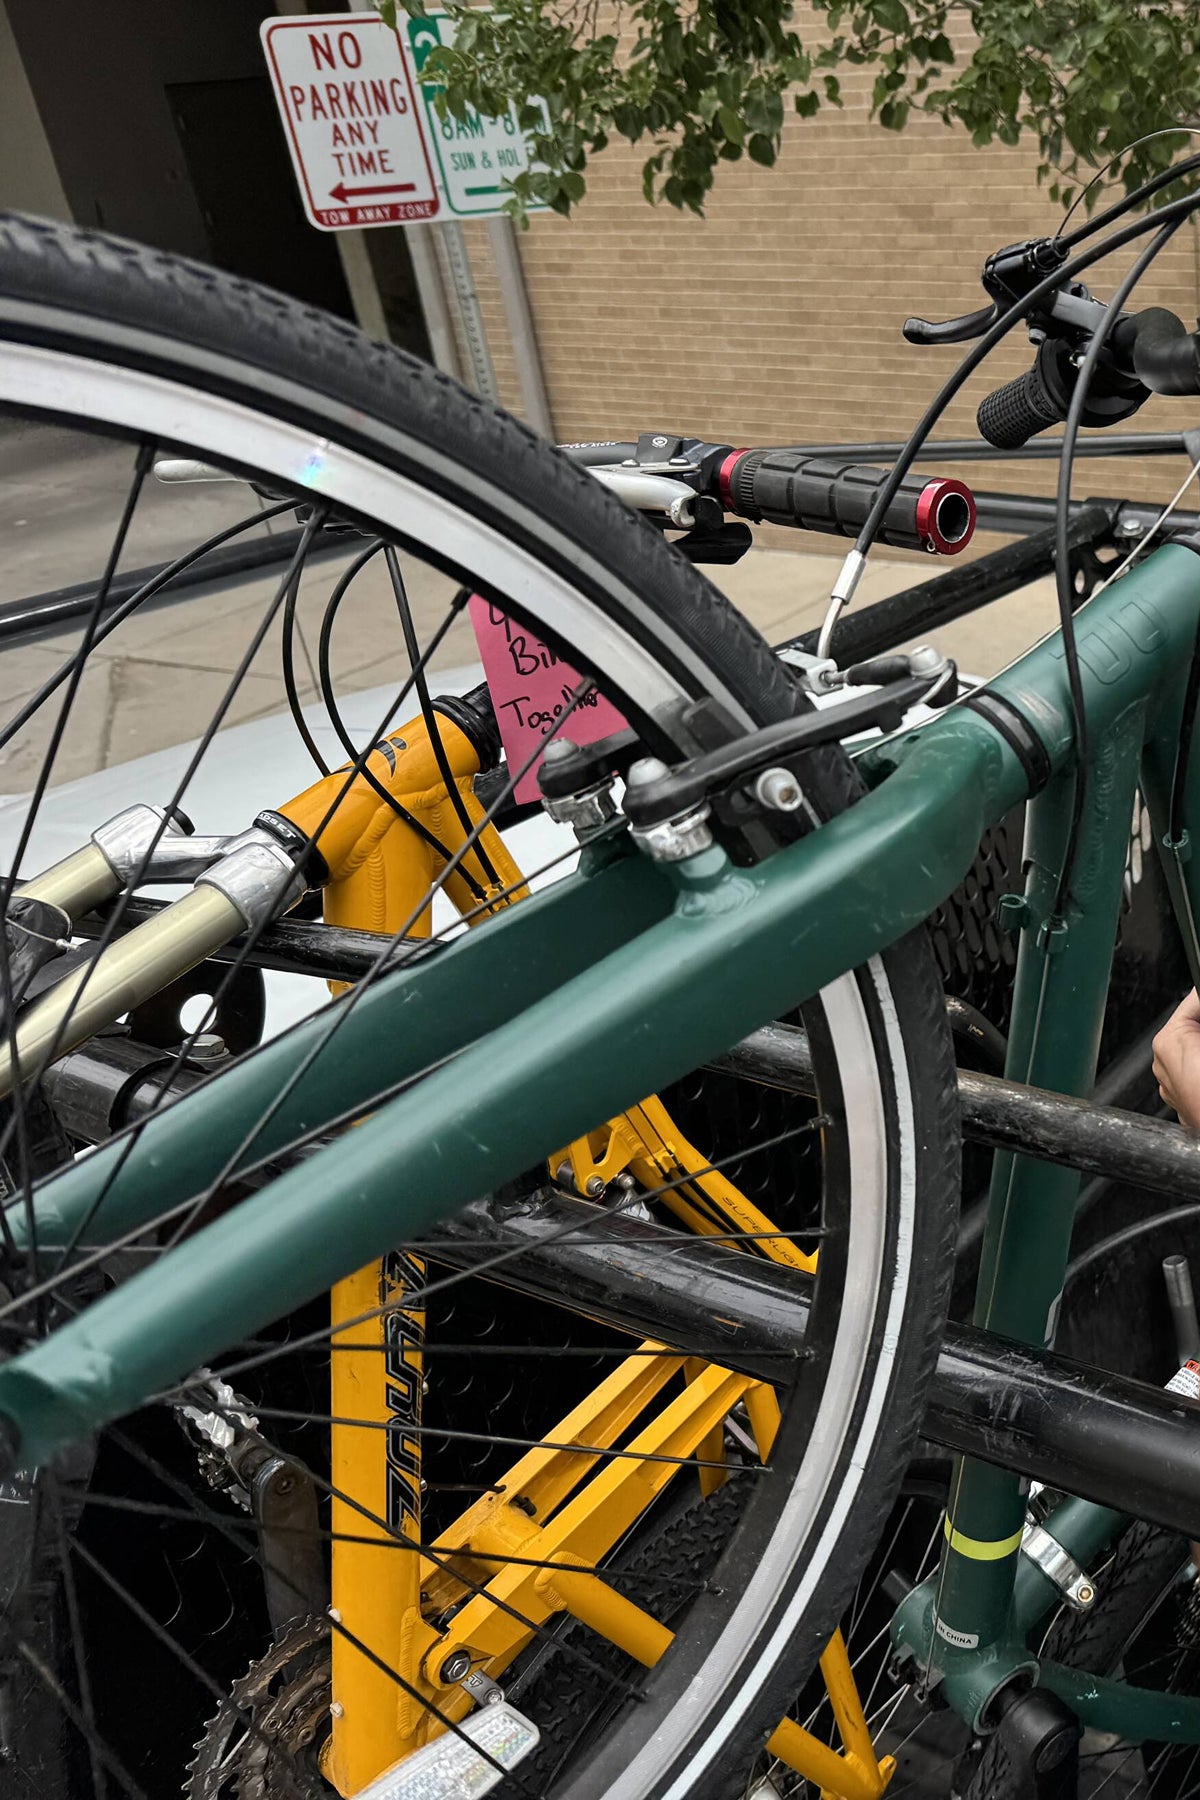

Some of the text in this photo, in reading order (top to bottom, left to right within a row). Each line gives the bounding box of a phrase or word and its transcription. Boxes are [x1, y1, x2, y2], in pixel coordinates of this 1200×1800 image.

[308, 31, 362, 71] NO
[290, 78, 408, 122] PARKING
[332, 120, 379, 148] ANY
[332, 149, 394, 177] TIME
[450, 152, 476, 171] SUN
[481, 151, 492, 169] &
[320, 202, 433, 225] TOW AWAY ZONE
[946, 1631, 972, 1645] CHINA
